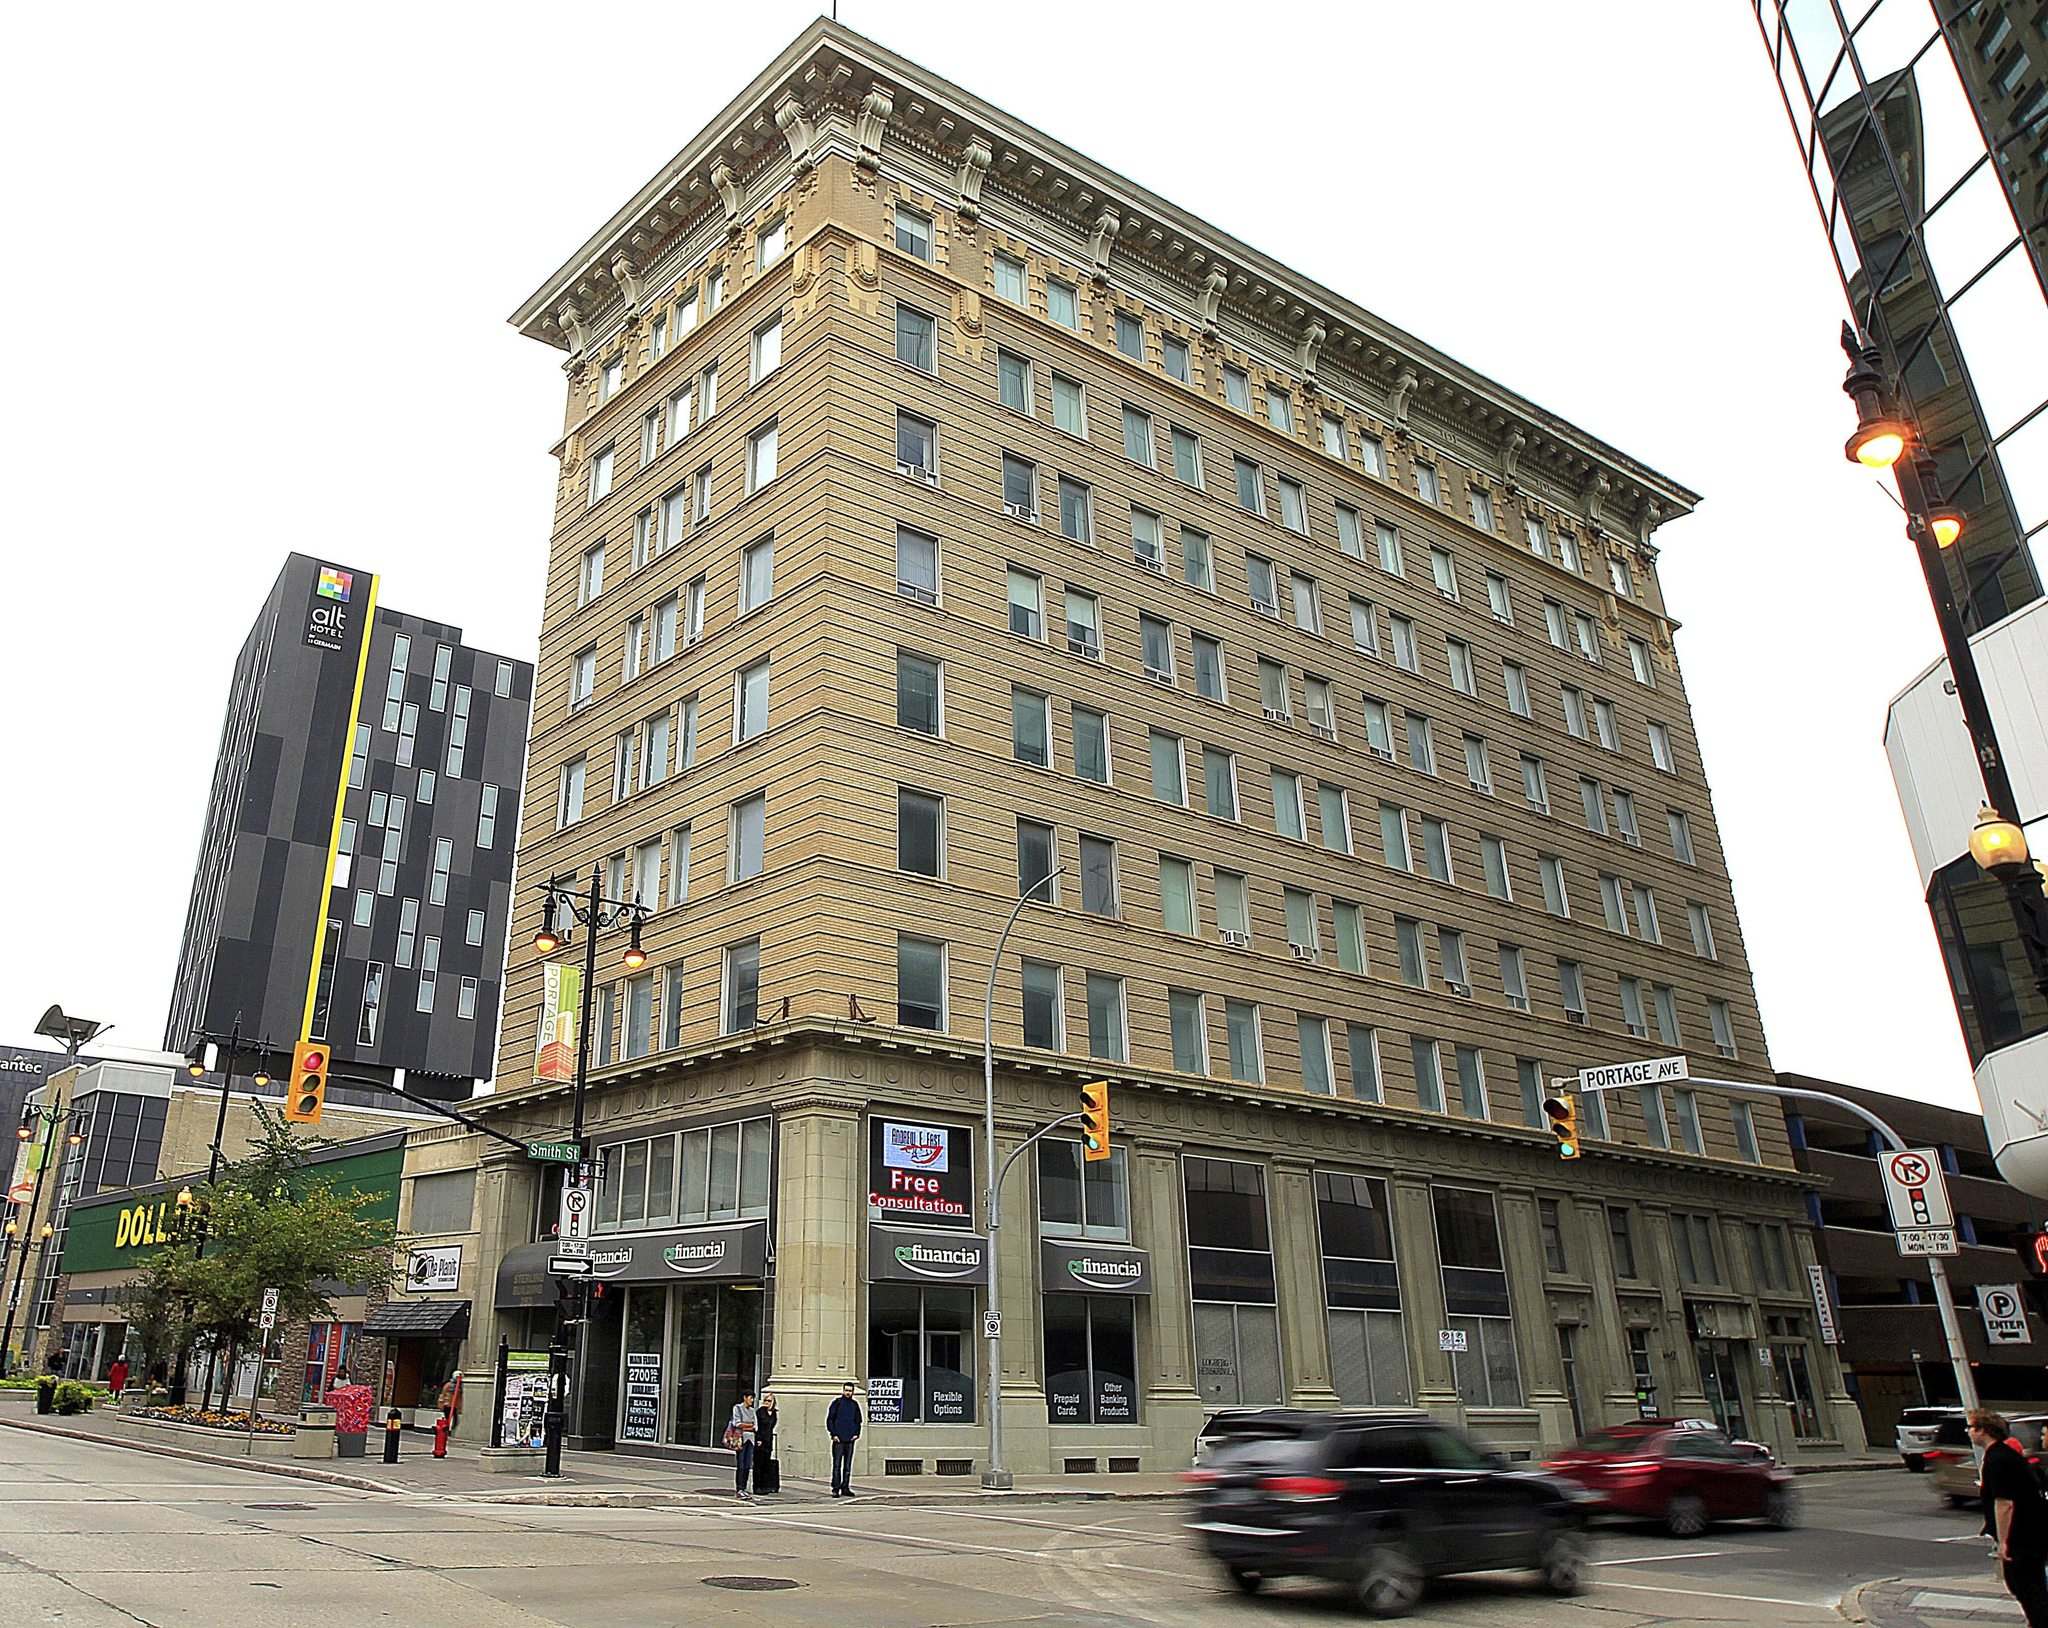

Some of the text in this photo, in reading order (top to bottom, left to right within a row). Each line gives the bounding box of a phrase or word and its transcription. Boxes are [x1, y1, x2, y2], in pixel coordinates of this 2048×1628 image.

[312, 605, 347, 630] alt
[309, 623, 344, 639] HOTEL
[543, 966, 559, 1041] PORTAGE
[0, 1060, 42, 1074] antec
[1586, 1061, 1681, 1088] PORTAGE AVE
[530, 1143, 578, 1160] Smith St
[891, 1170, 940, 1193] Free
[868, 1192, 964, 1214] Consultation
[115, 1202, 170, 1248] DOLL
[1902, 1233, 1920, 1241] 7:00
[1927, 1232, 1950, 1241] 17:30
[1907, 1243, 1925, 1251] MON
[1935, 1243, 1949, 1251] FRI
[589, 1247, 633, 1264] financial
[1988, 1320, 2025, 1330] ENTER
[628, 1368, 650, 1382] 2700
[870, 1380, 899, 1388] SPACE
[1104, 1382, 1123, 1392] Other
[867, 1389, 900, 1397] FOR LEASE
[933, 1391, 963, 1402] Flexible
[1053, 1393, 1080, 1405] Prepaid
[1100, 1394, 1128, 1406] Banking
[933, 1404, 963, 1416] Options
[1057, 1405, 1078, 1416] Cards
[1099, 1406, 1129, 1416] Products
[629, 1416, 654, 1425] REALTY
[870, 1413, 900, 1422] 943-2501
